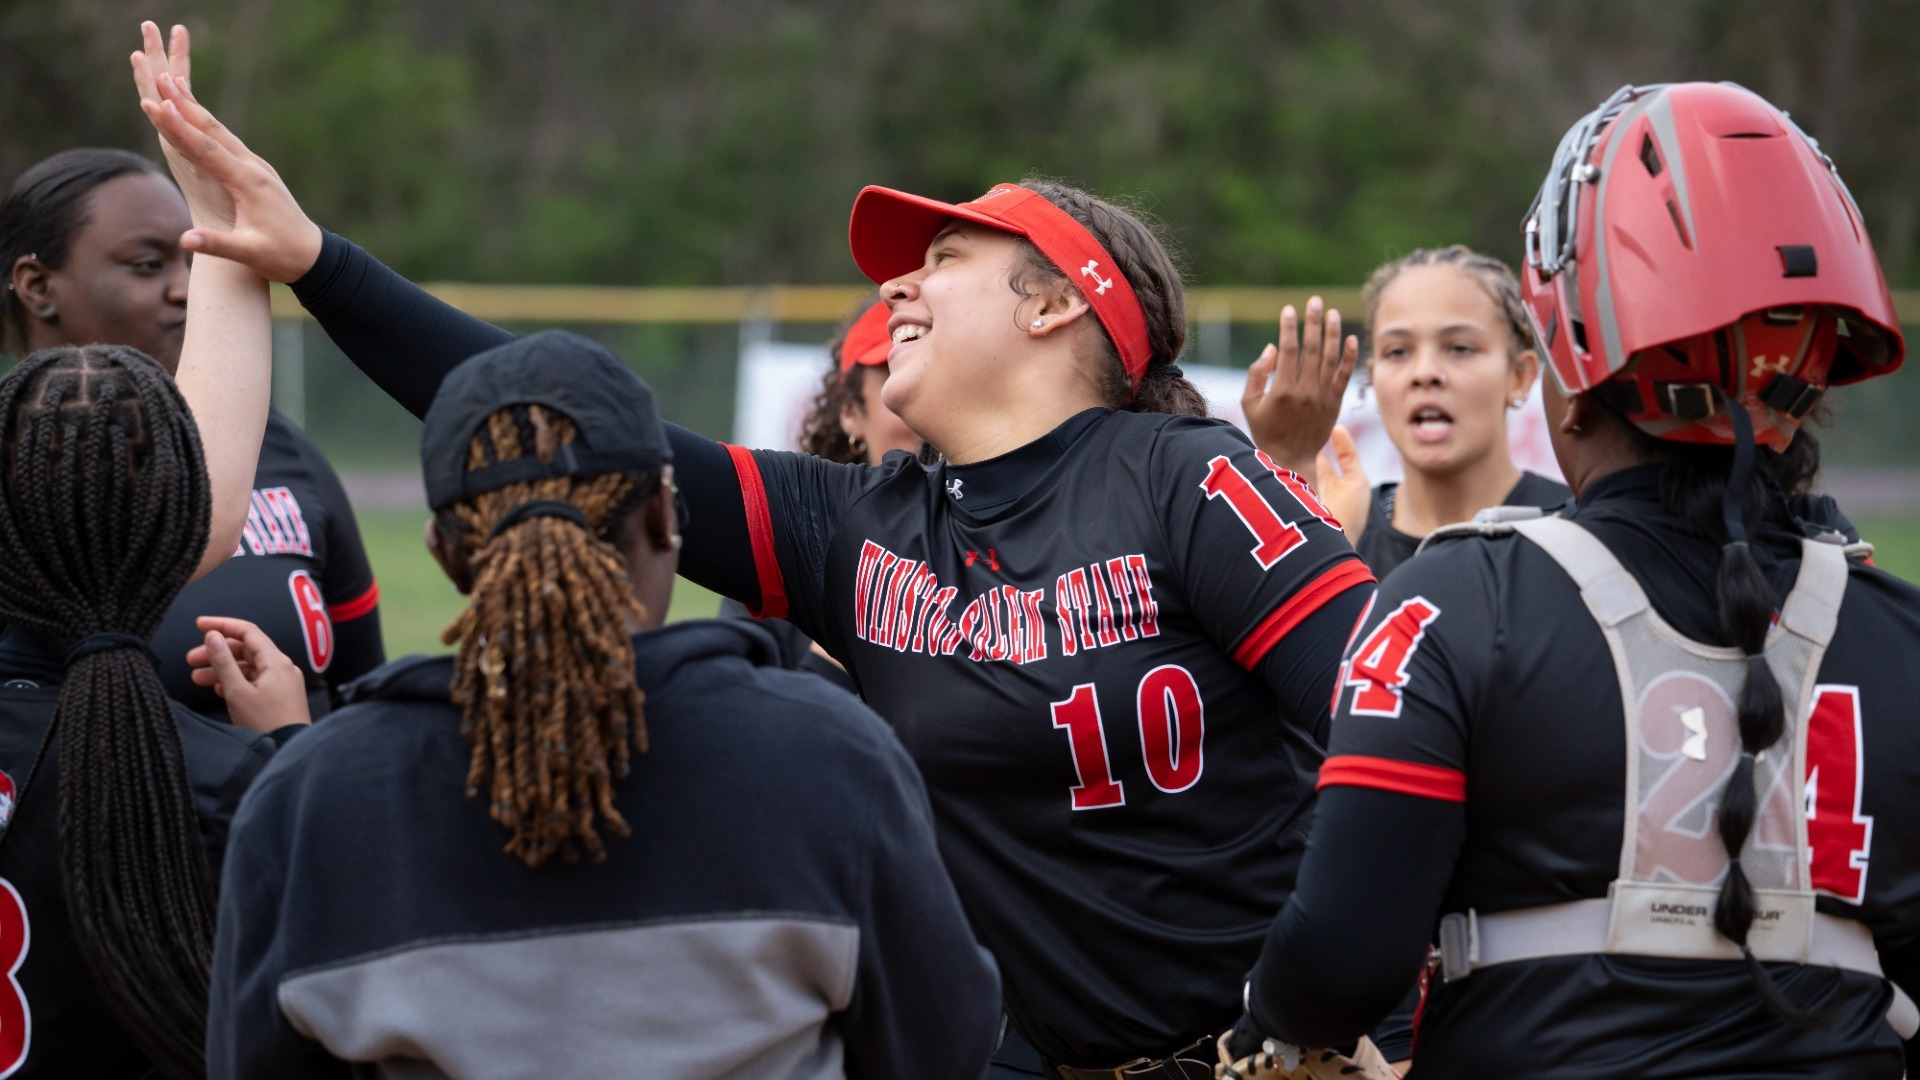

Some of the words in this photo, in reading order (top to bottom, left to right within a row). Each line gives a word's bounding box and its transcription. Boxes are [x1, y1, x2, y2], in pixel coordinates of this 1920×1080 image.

[288, 569, 334, 674] 6
[1055, 553, 1160, 656] STATE
[1050, 664, 1204, 811] 10
[1650, 903, 1708, 916] UNDER
